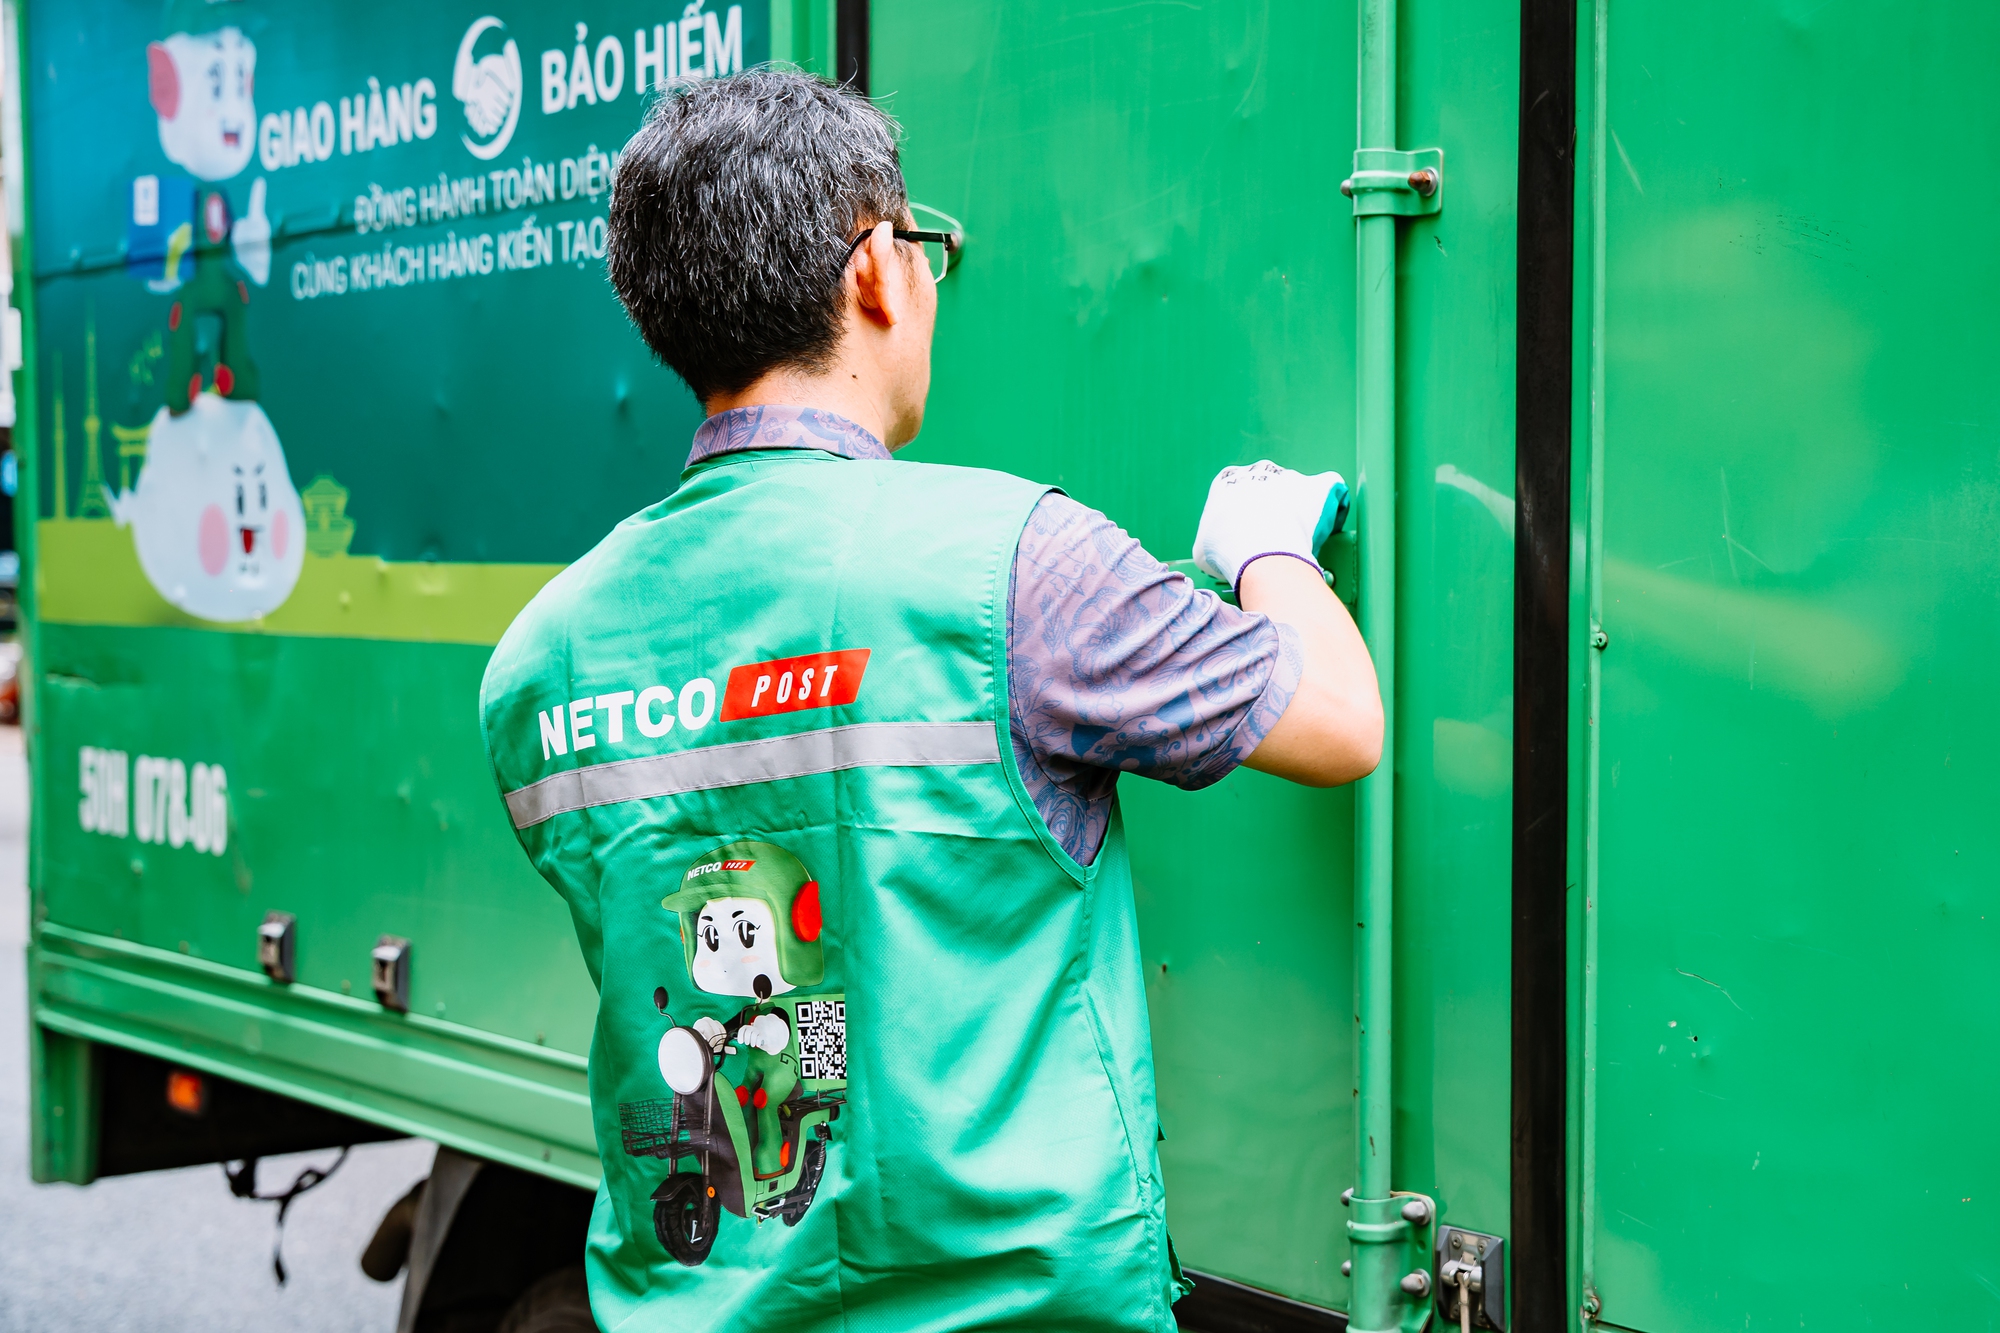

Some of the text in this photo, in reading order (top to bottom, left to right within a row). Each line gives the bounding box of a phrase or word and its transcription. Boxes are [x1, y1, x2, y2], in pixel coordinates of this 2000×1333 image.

[258, 100, 335, 172] GIAO
[339, 75, 437, 156] HÀNG
[541, 21, 625, 115] BẢO
[419, 171, 486, 223] HÀNH
[489, 156, 556, 214] TOÀN
[560, 143, 620, 204] DIỆN
[291, 214, 608, 300] CÙNG KHÁCH HÀNG KIẾN TẠO
[538, 664, 838, 761] NETCO POST
[78, 745, 129, 839] 50H
[687, 861, 748, 881] NETCO POST
